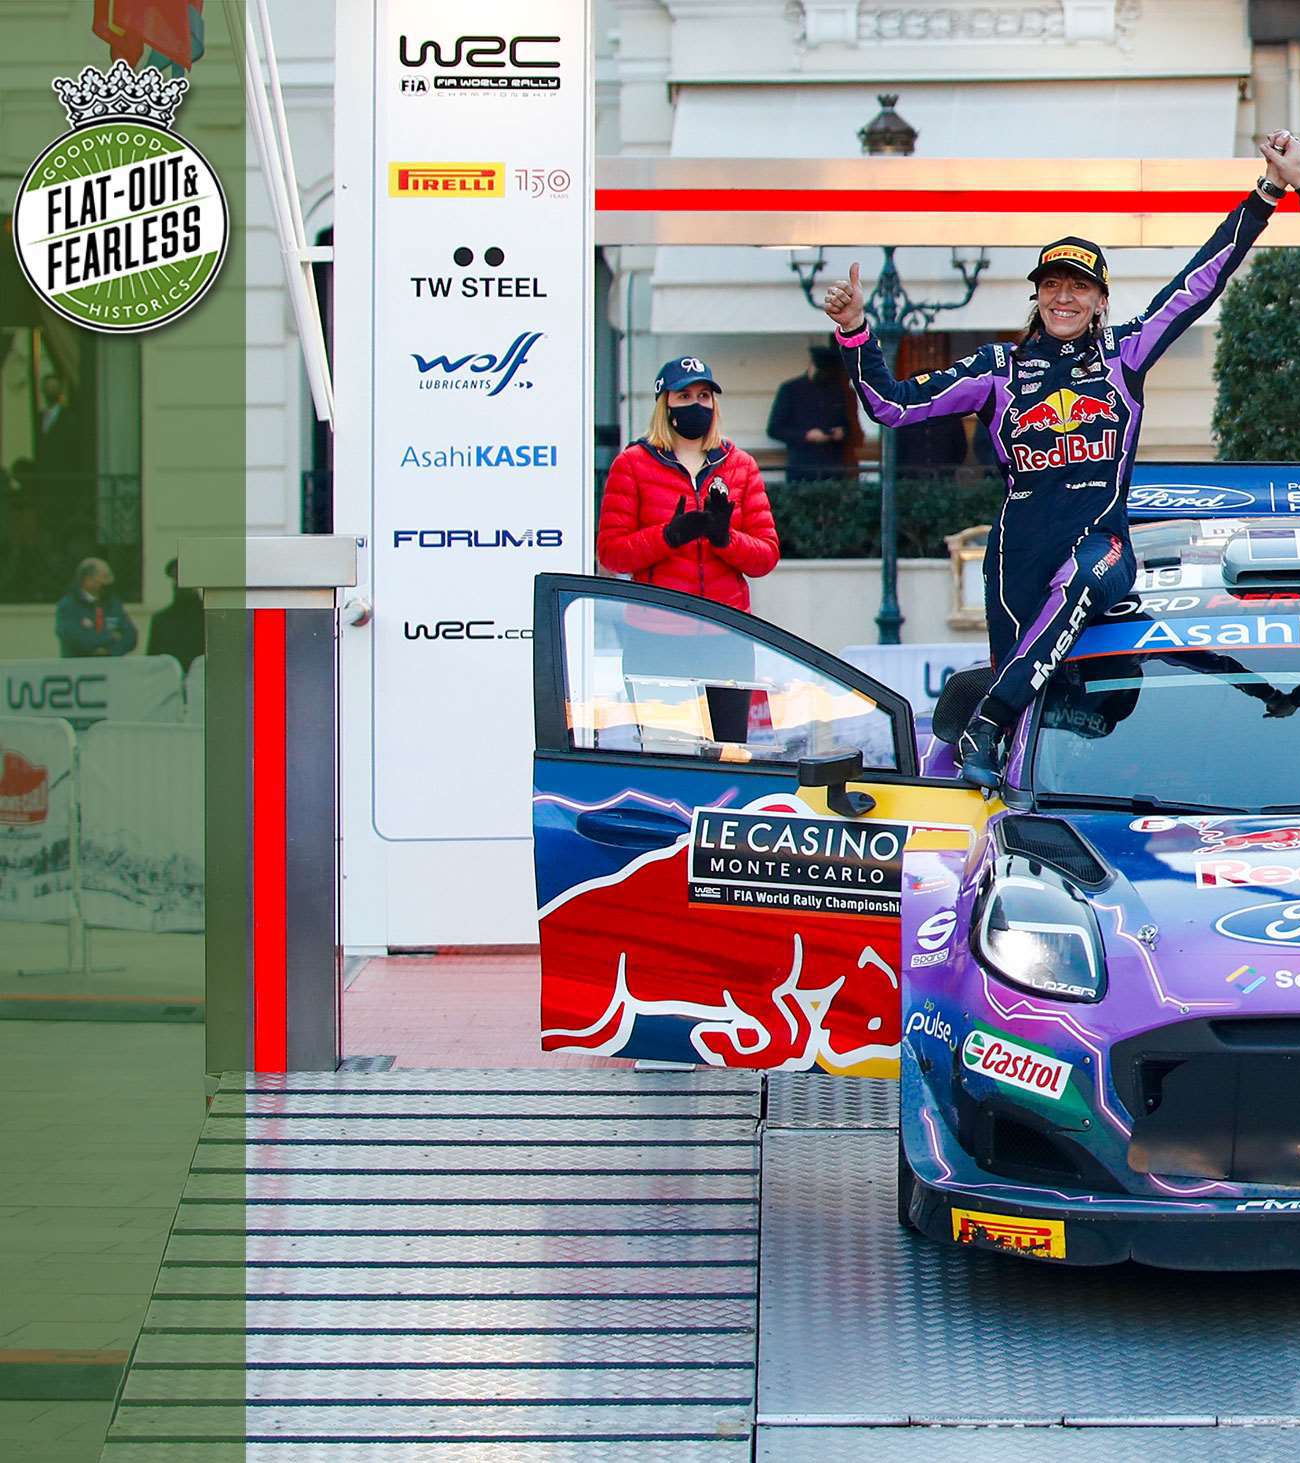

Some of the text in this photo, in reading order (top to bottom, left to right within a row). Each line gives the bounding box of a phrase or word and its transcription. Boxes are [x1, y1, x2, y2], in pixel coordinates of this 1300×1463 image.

[399, 35, 561, 67] WRC
[460, 79, 508, 87] WORLD
[510, 79, 558, 88] RALLY
[397, 168, 496, 191] PIRELLI
[410, 277, 548, 298] TW STEEL
[419, 379, 492, 390] LUBRICANTS
[400, 445, 558, 468] AsahiKASEI
[1011, 429, 1117, 473] Red Bull
[1128, 487, 1225, 508] Ford
[393, 529, 563, 548] FORUM8
[1103, 596, 1200, 617] ORD
[403, 621, 534, 640] WRC.co
[7, 675, 108, 710] WRC
[700, 819, 901, 862] LE CASINO
[733, 889, 754, 902] FIA
[756, 891, 790, 905] World
[793, 894, 822, 909] Rally
[825, 896, 901, 913] Championshi
[912, 951, 948, 965] sparco
[1031, 977, 1097, 999] LAZER
[905, 1010, 952, 1043] pulse
[982, 1041, 1063, 1093] Castrol
